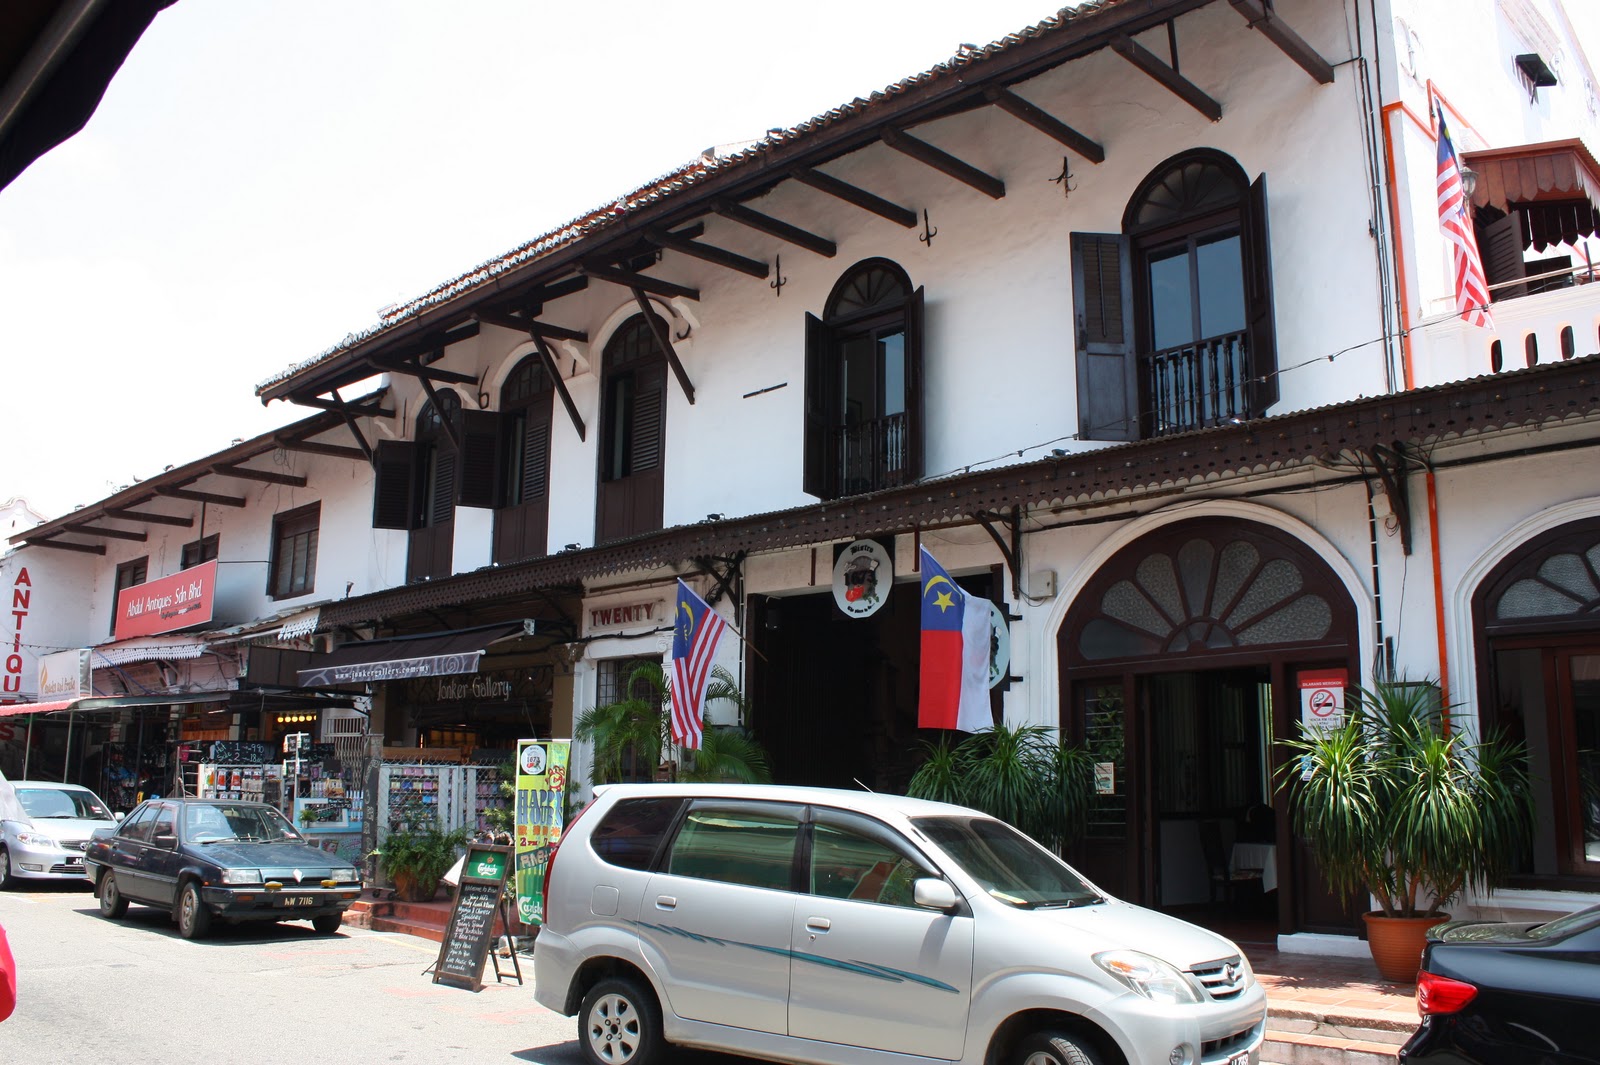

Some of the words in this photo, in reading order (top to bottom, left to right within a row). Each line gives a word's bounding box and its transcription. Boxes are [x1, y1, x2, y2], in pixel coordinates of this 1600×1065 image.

[126, 596, 144, 617] Abdul
[145, 594, 172, 614] Antiques
[592, 603, 655, 626] TWENTY
[335, 665, 430, 680] www.jonkergallery.com.my
[437, 680, 468, 700] Jonker
[472, 676, 510, 701] Gallery
[517, 790, 564, 808] HAPPY
[517, 806, 563, 825] HOURS
[478, 863, 497, 875] Carlsberg
[299, 897, 313, 905] 7116
